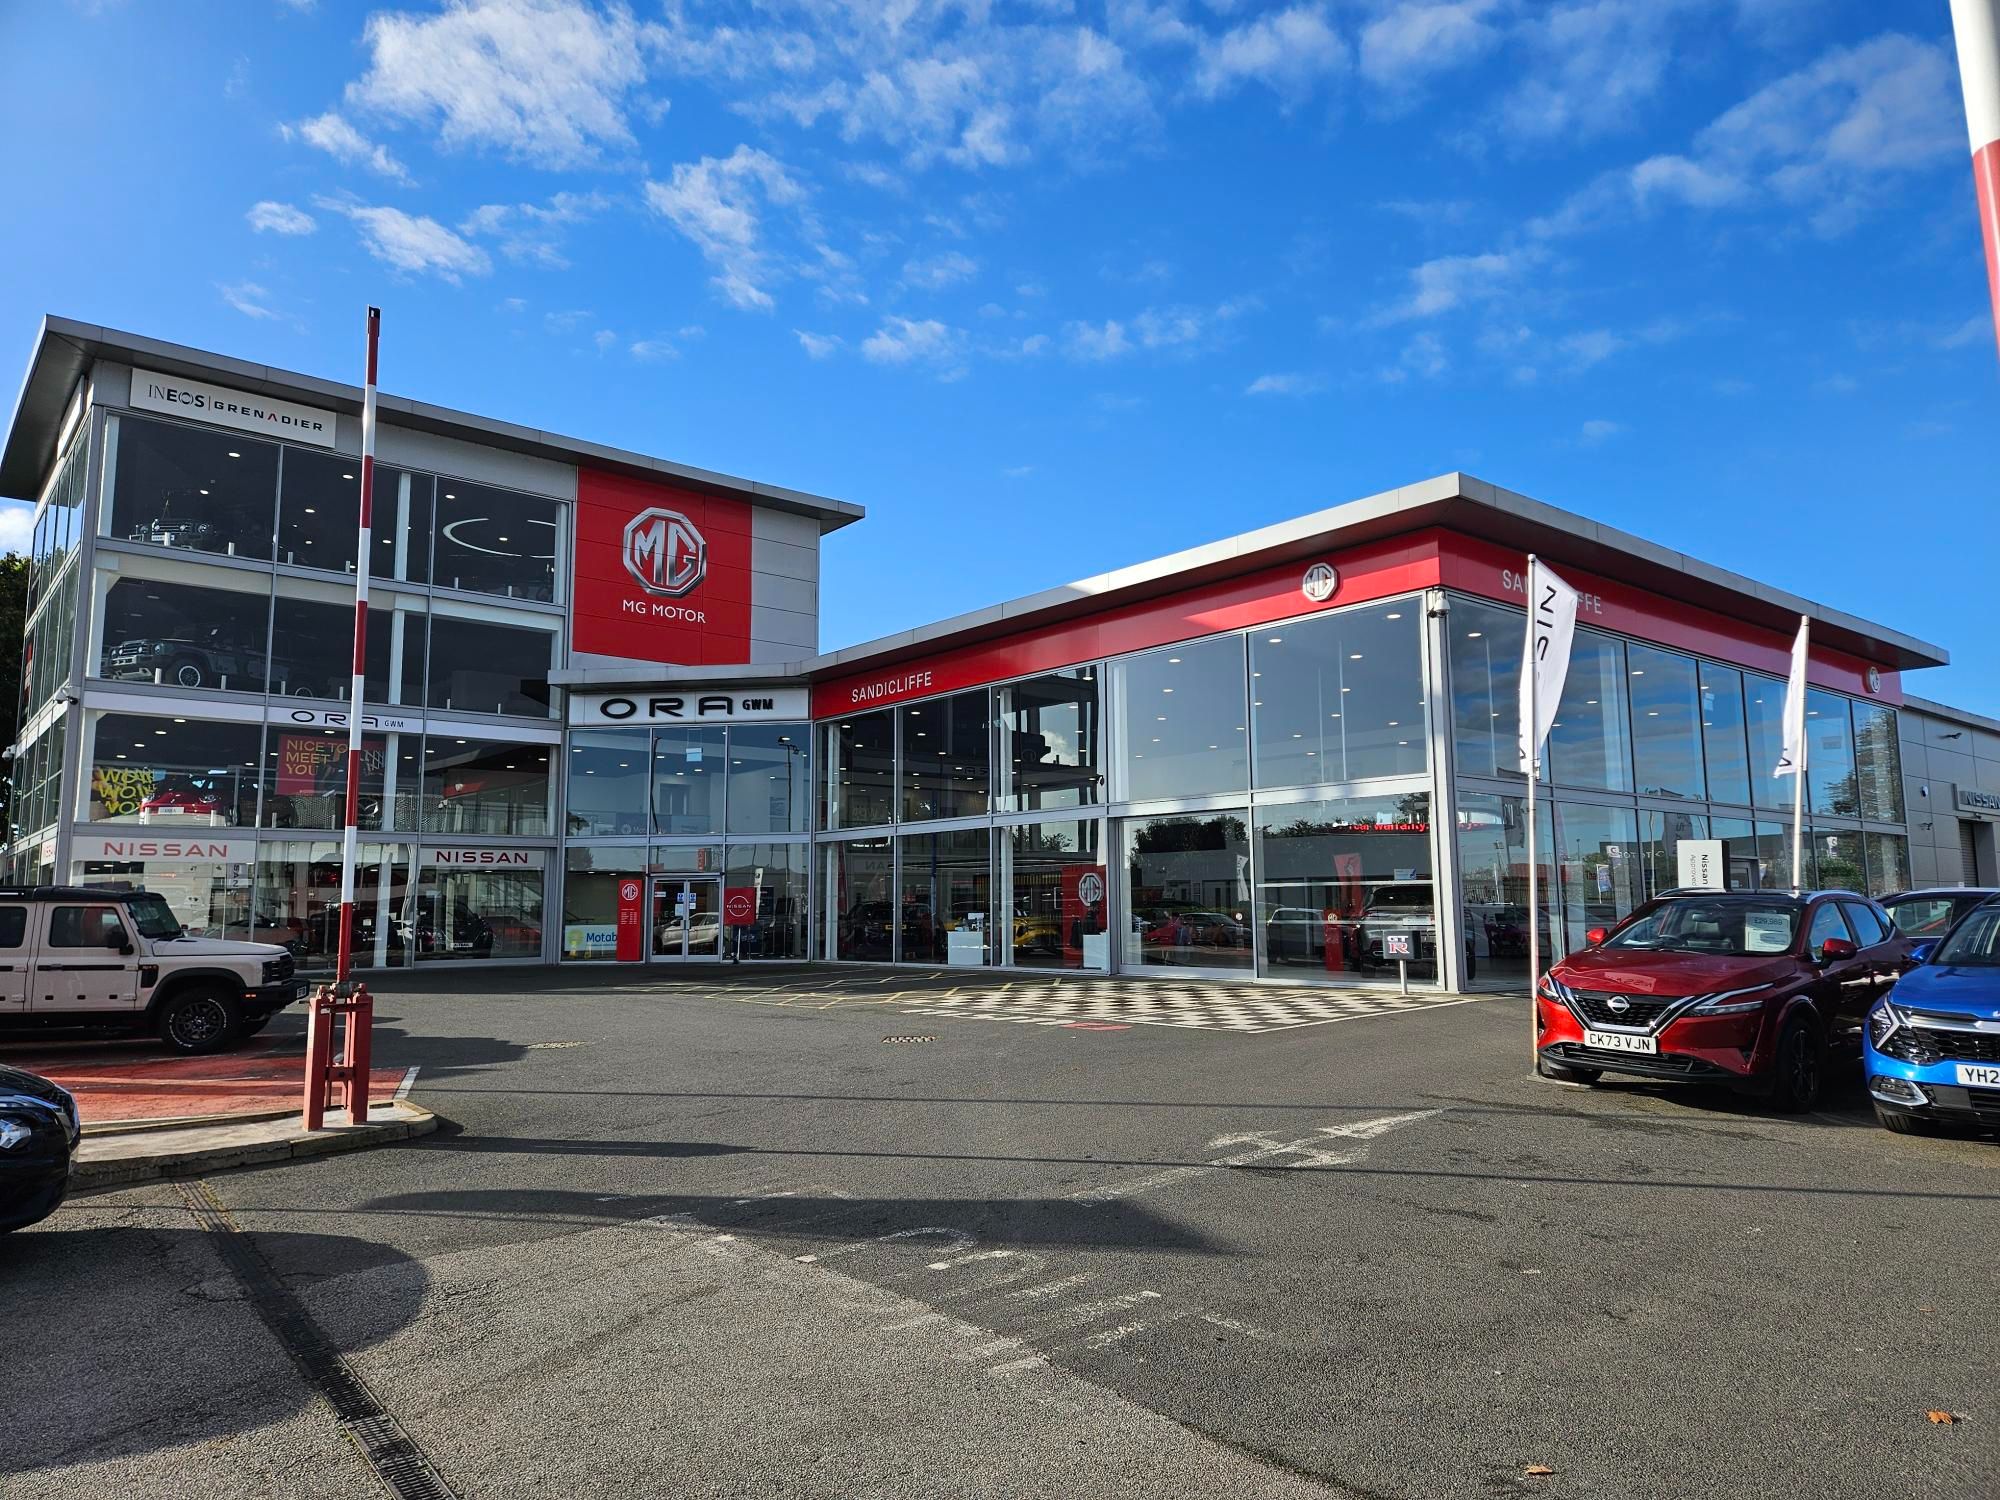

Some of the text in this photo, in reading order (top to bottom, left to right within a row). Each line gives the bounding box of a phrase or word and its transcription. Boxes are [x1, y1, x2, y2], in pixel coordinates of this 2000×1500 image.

[148, 384, 323, 432] INEOS GRENADIER
[633, 517, 698, 589] MG
[1305, 566, 1332, 598] MG
[622, 599, 706, 623] MG MOTOR
[851, 671, 933, 703] SANDICLIFFE
[599, 697, 774, 719] ORA GWM
[384, 720, 404, 728] GWM
[286, 739, 348, 753] NICE TO
[286, 752, 331, 765] MEET
[286, 764, 319, 776] YOU
[103, 842, 228, 858] NISSAN
[435, 851, 528, 864] NISSAN
[1701, 854, 1709, 885] Nissan
[623, 885, 638, 899] MG
[586, 932, 618, 942] Motab
[1589, 1033, 1651, 1050] CK73 VJN
